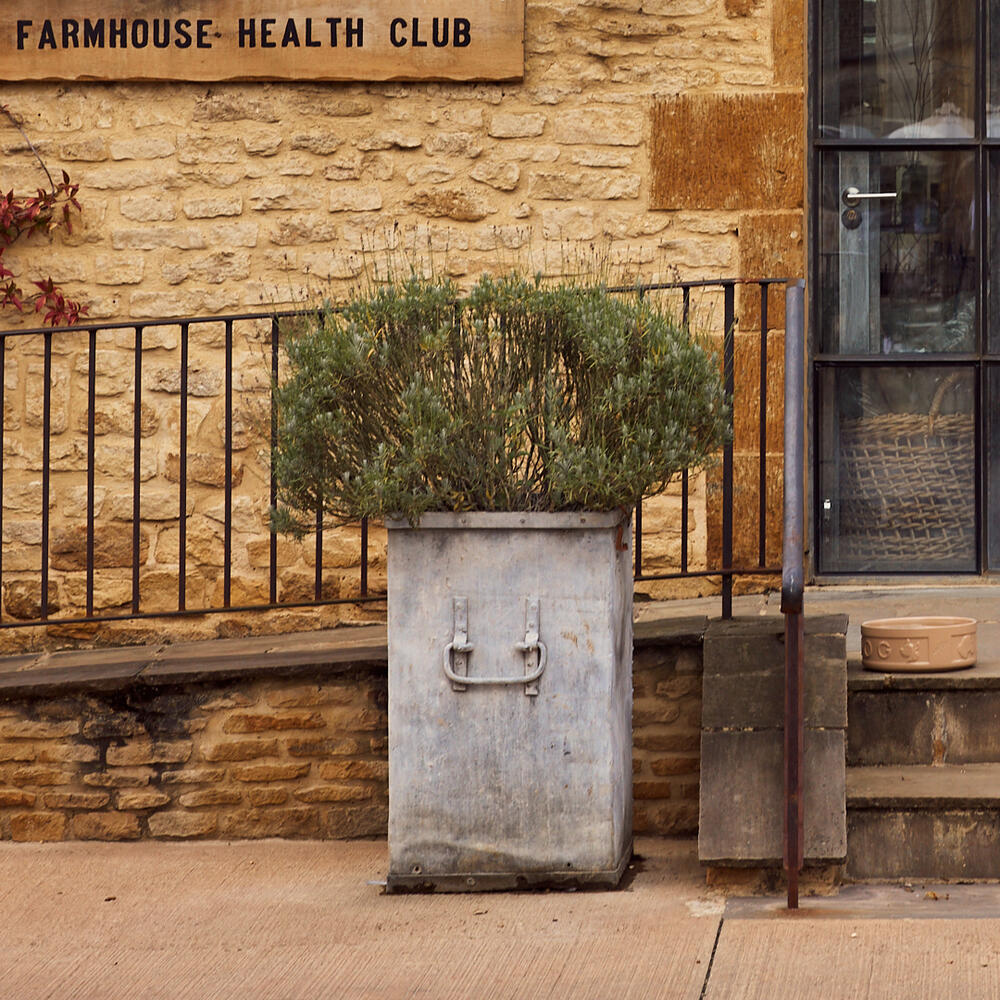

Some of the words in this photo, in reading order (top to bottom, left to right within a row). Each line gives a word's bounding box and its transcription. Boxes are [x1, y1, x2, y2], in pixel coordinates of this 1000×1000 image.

[17, 18, 212, 50] FARMHOUSE
[239, 18, 363, 48] HEALTH
[390, 18, 470, 47] CLUB
